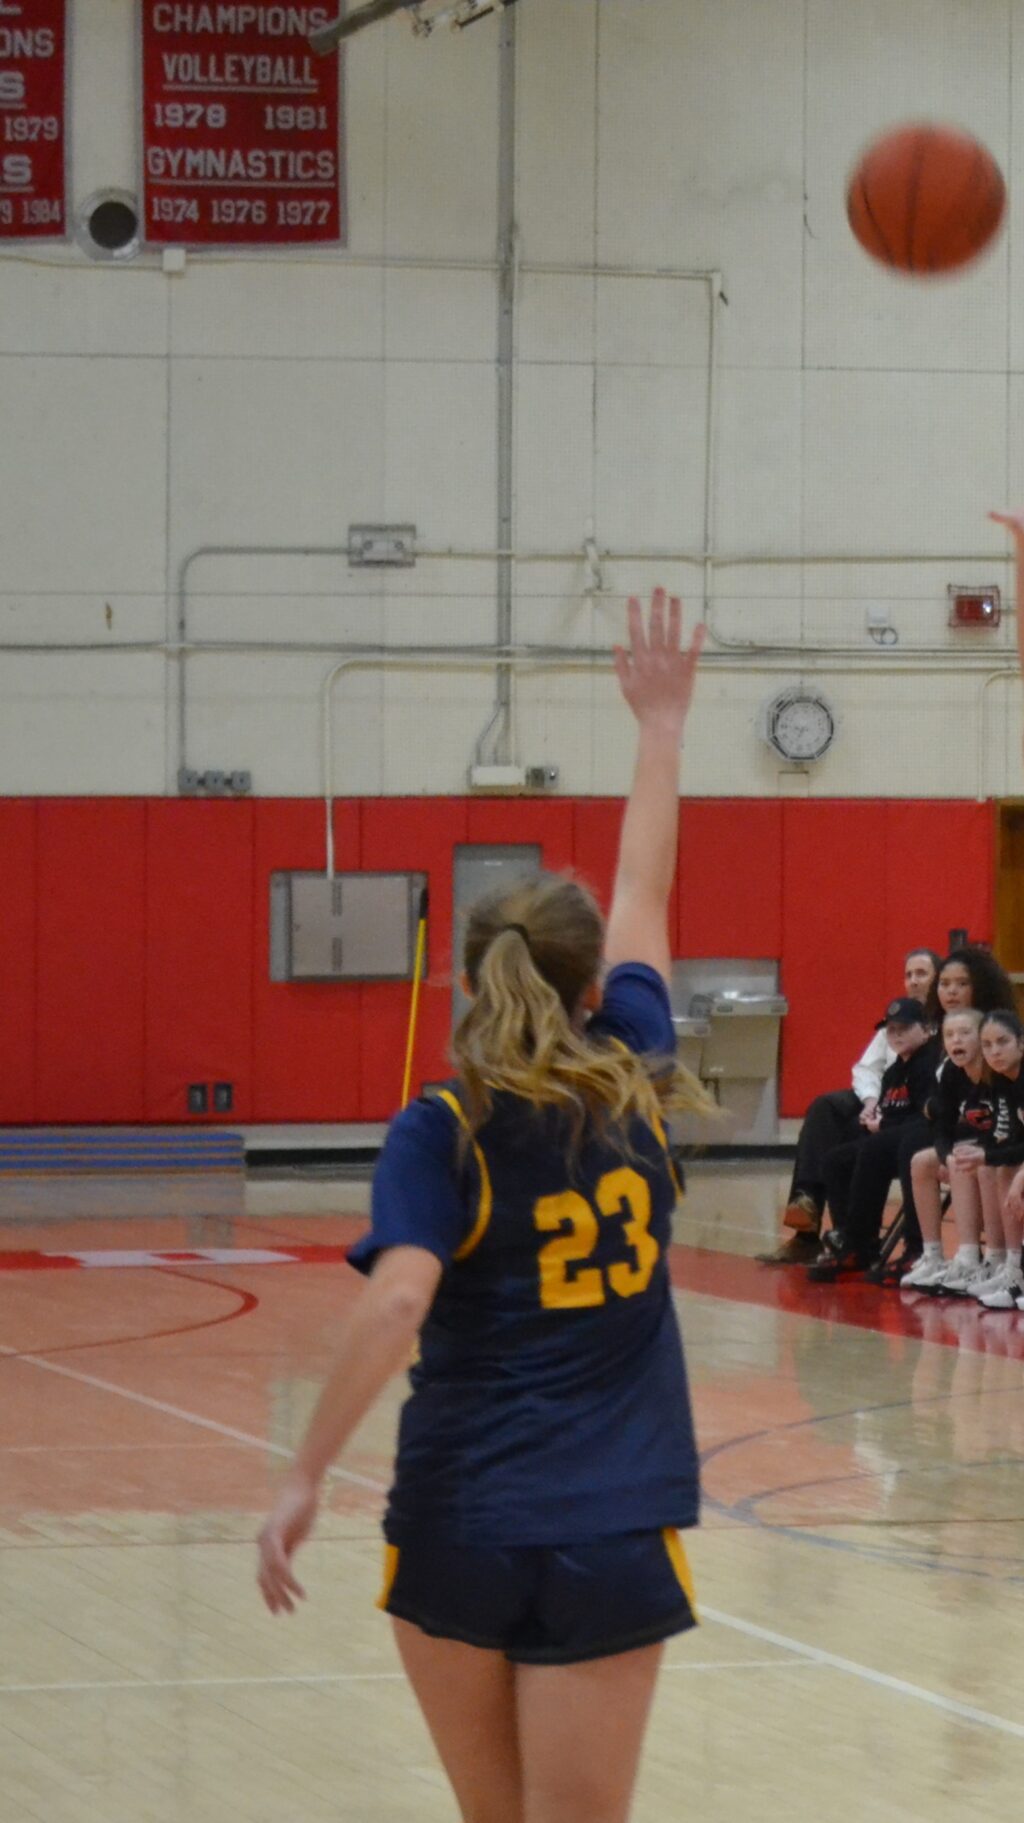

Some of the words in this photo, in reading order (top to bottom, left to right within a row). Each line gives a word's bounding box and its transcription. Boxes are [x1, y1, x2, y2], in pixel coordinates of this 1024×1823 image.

[153, 4, 328, 36] CHAMPIONS
[162, 53, 319, 84] VOLLEYBALL
[4, 116, 58, 141] 1979
[154, 103, 226, 129] 1978
[265, 105, 327, 130] 1981
[149, 146, 335, 179] GYMNASTICS
[152, 198, 199, 224] 1974
[211, 200, 267, 225] 1976
[277, 201, 331, 226] 1977
[533, 1166, 659, 1309] 23
